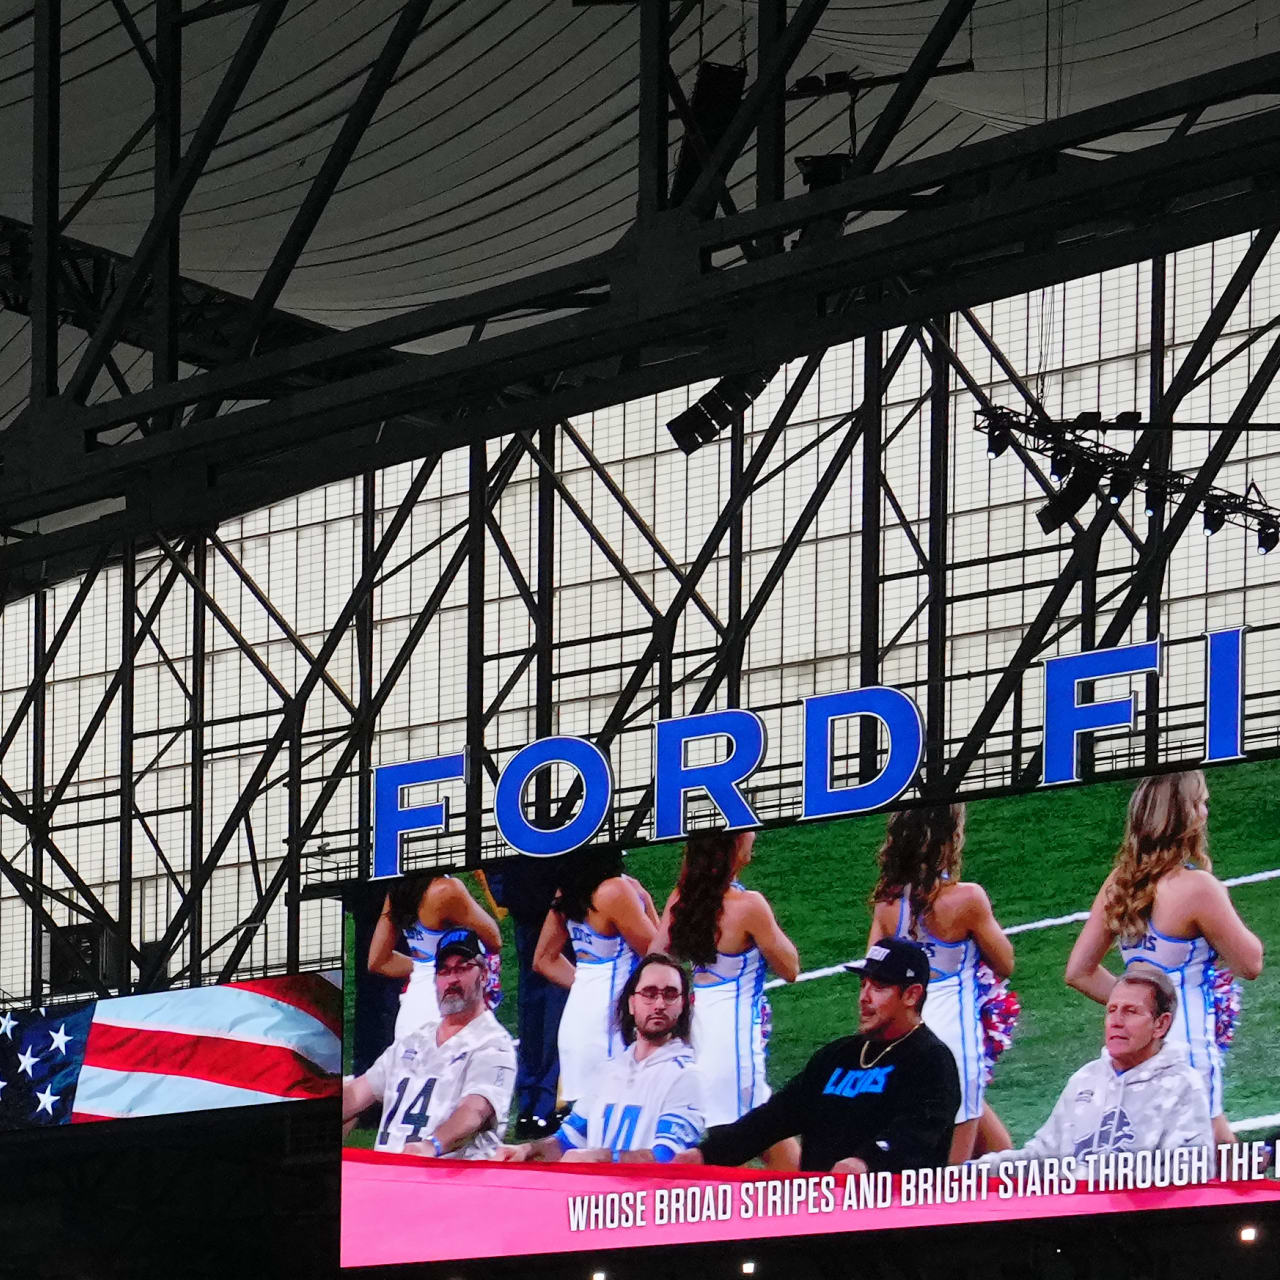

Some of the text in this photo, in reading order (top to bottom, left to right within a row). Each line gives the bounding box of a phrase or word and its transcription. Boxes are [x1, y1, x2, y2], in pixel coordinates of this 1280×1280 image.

[370, 684, 927, 880] FORD
[379, 1076, 438, 1146] 14
[568, 1141, 1266, 1232] WHOSE BROAD STRIPES AND BRIGHT STARS THROUGH THE
